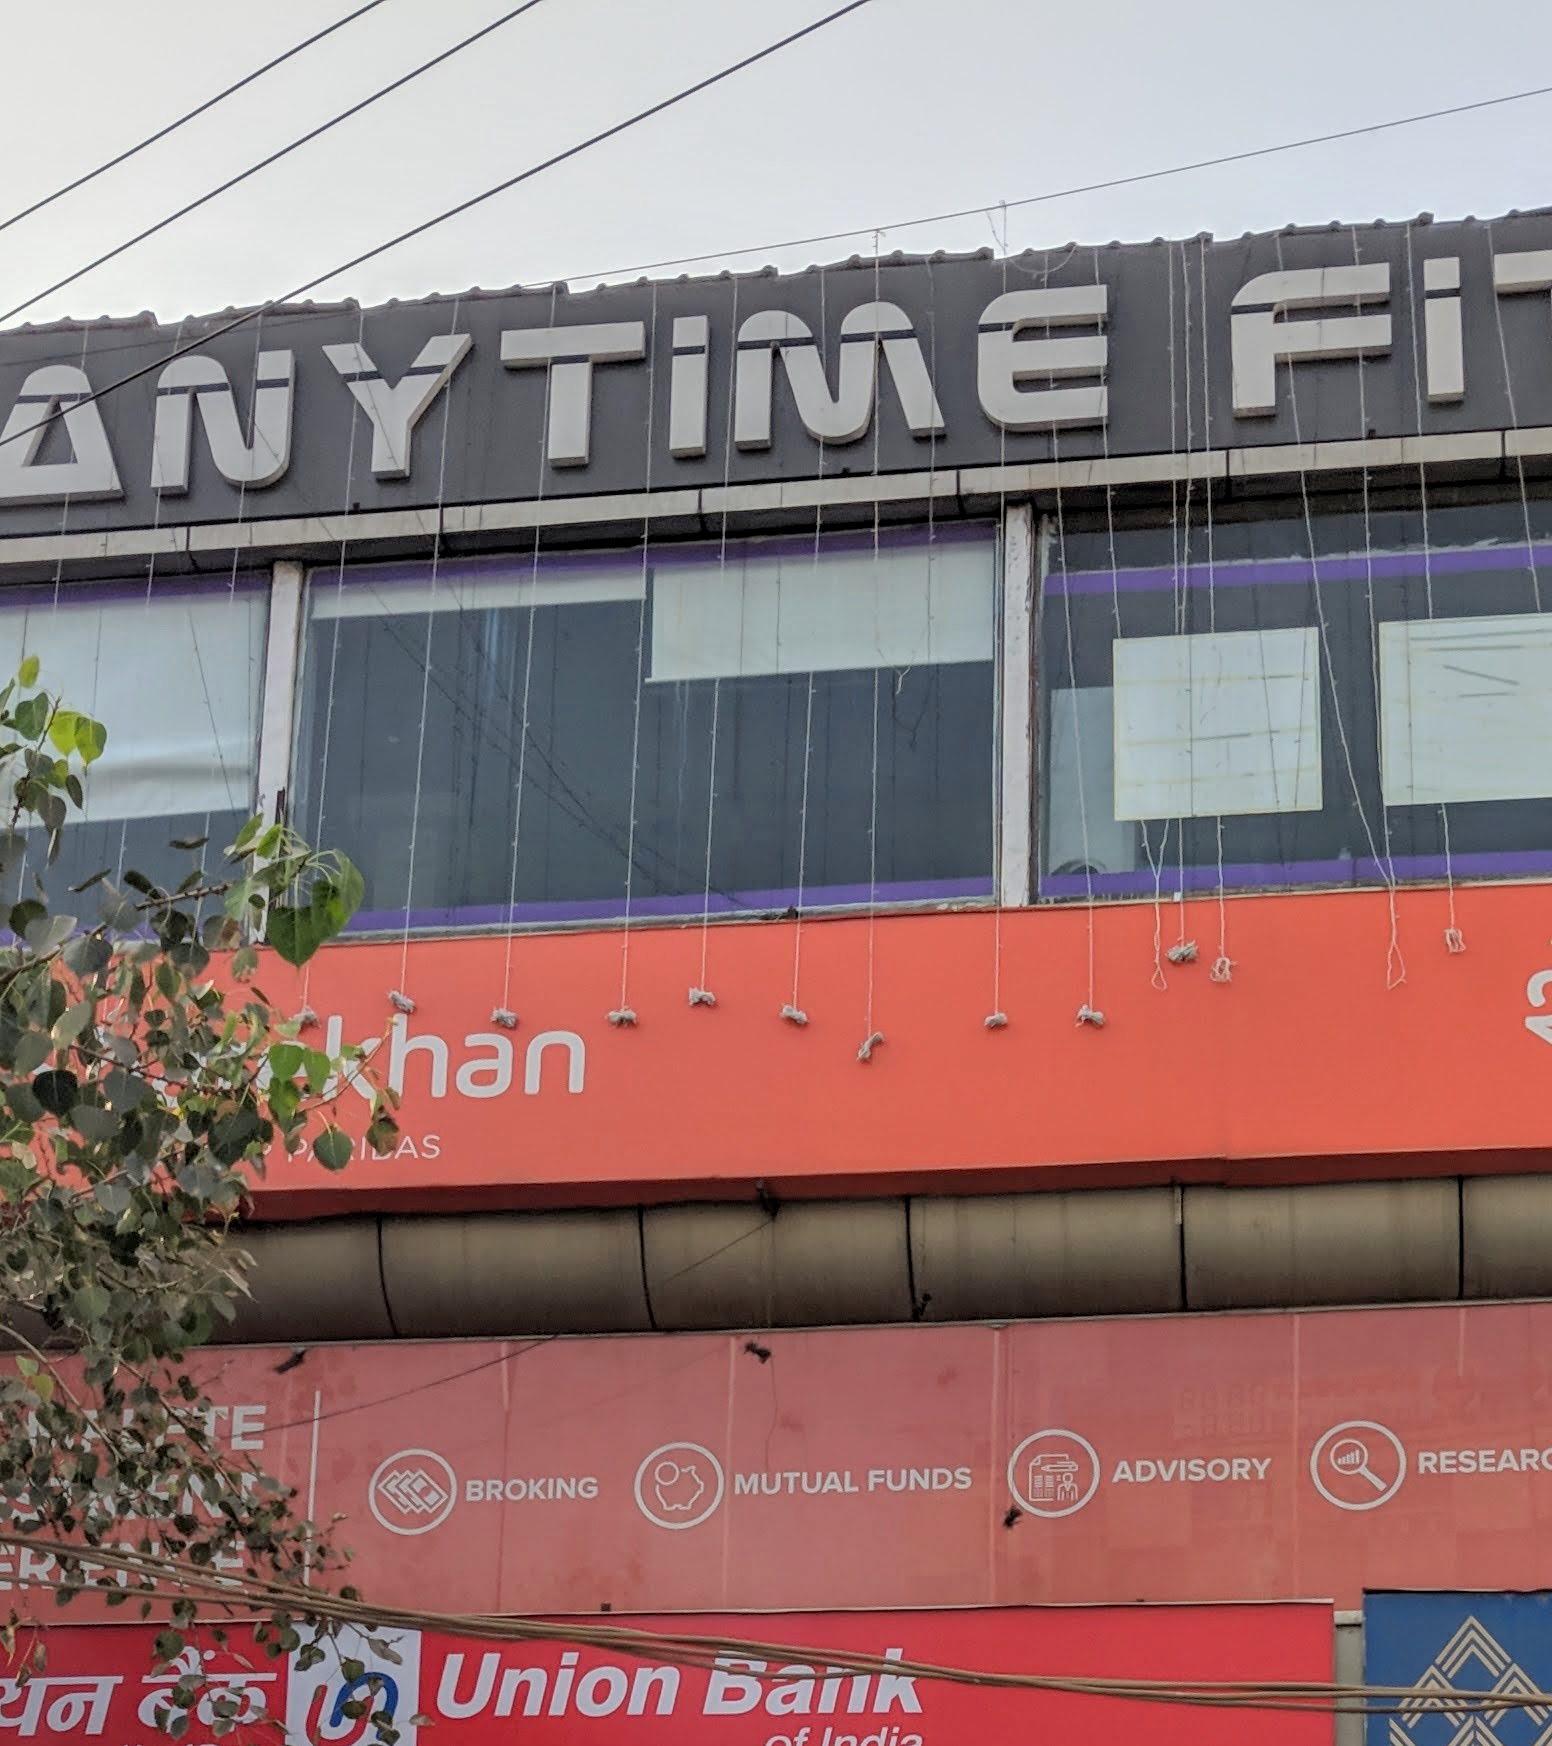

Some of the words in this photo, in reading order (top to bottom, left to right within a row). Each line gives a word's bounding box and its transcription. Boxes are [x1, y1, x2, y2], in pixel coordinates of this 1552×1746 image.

[733, 1470, 859, 1496] MUTUAL
[867, 1467, 973, 1492] FUNDS
[1112, 1457, 1273, 1484] ADVISORY
[465, 1477, 599, 1502] BROKING
[437, 1652, 677, 1718] Union
[703, 1649, 923, 1715] Bank
